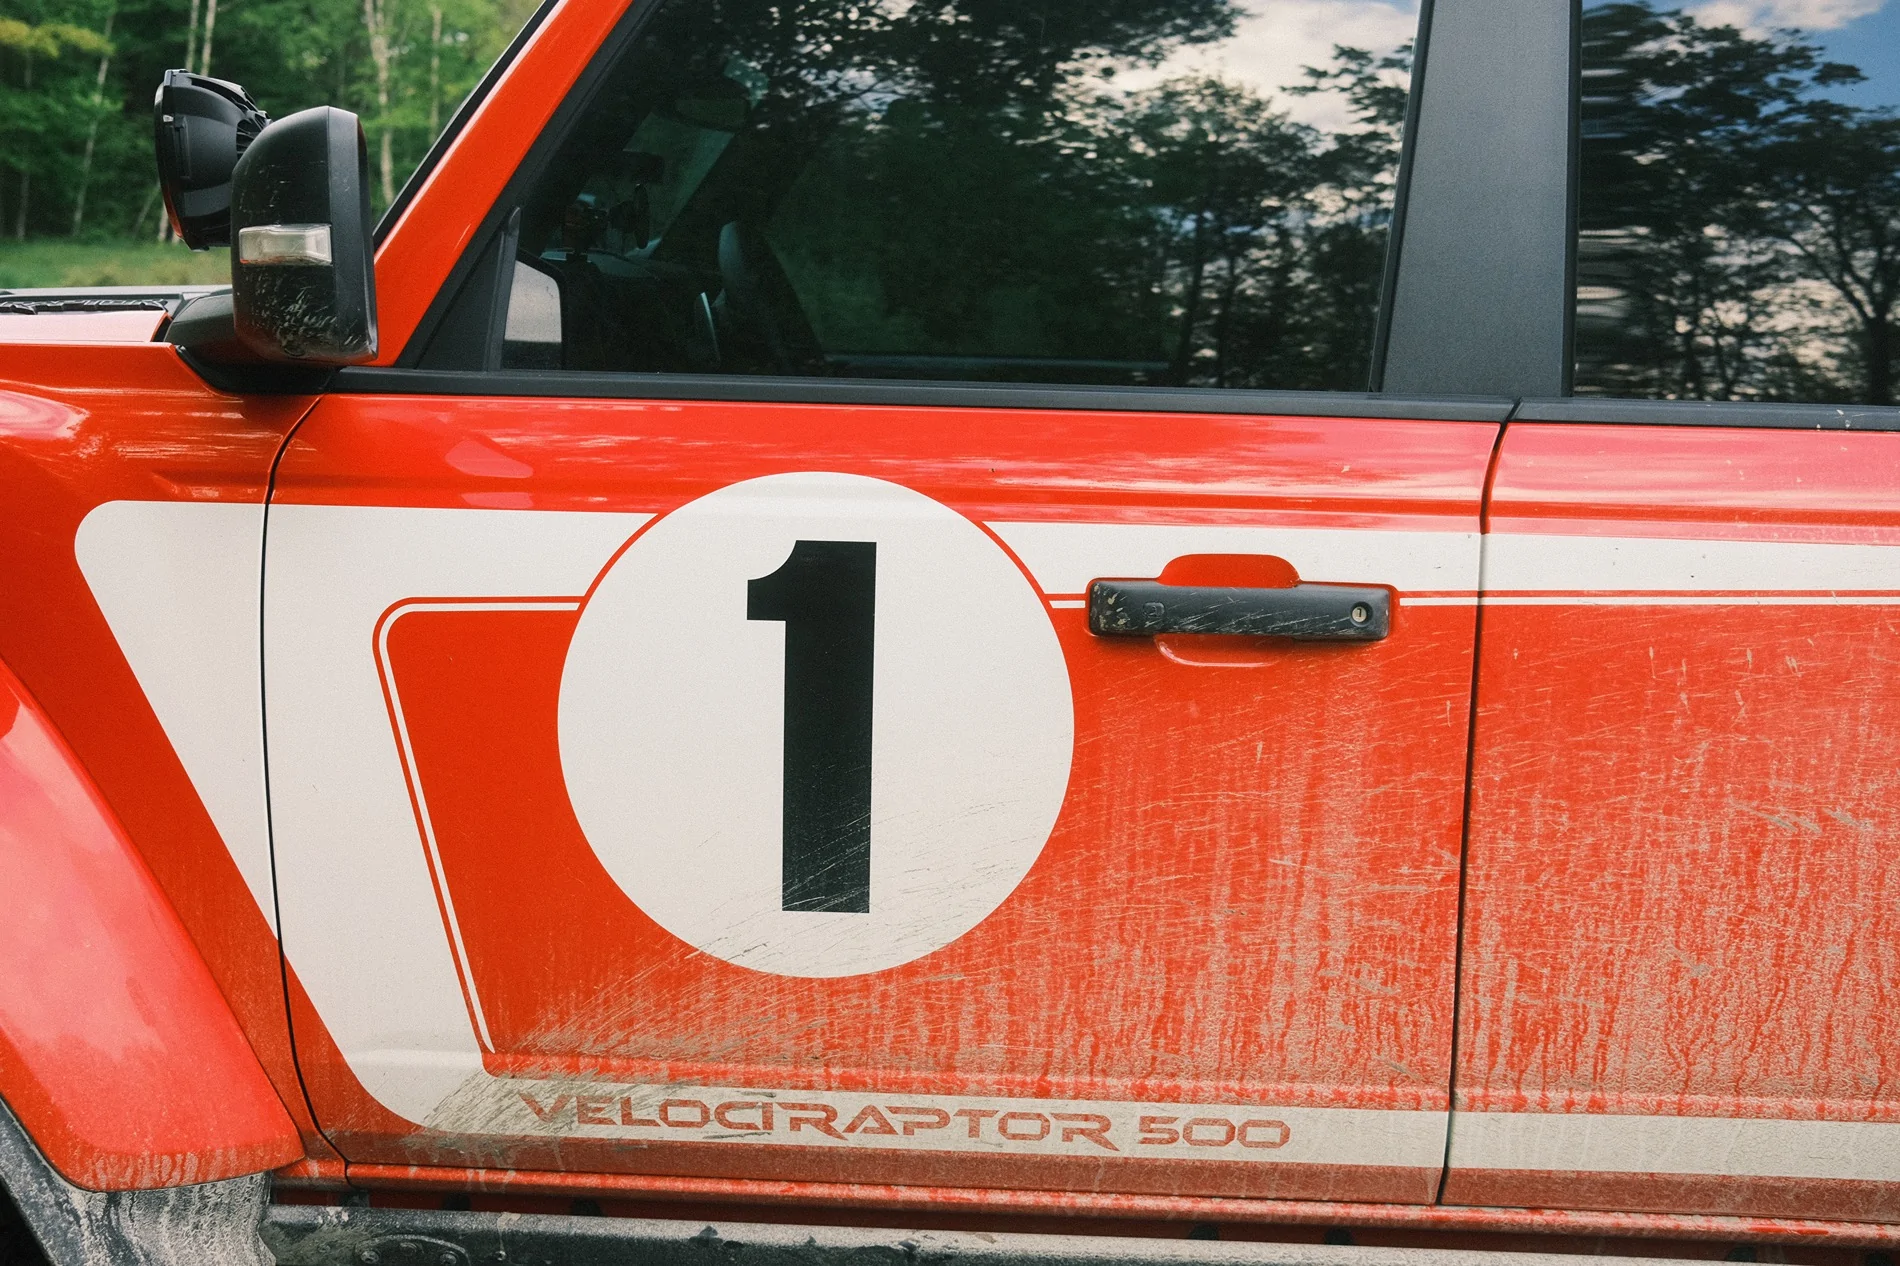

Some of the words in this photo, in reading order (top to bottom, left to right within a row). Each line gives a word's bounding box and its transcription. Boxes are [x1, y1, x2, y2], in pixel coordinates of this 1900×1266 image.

[747, 540, 877, 913] 1
[518, 1091, 1120, 1152] VELOCIRAPTOR
[1137, 1114, 1291, 1149] 500
